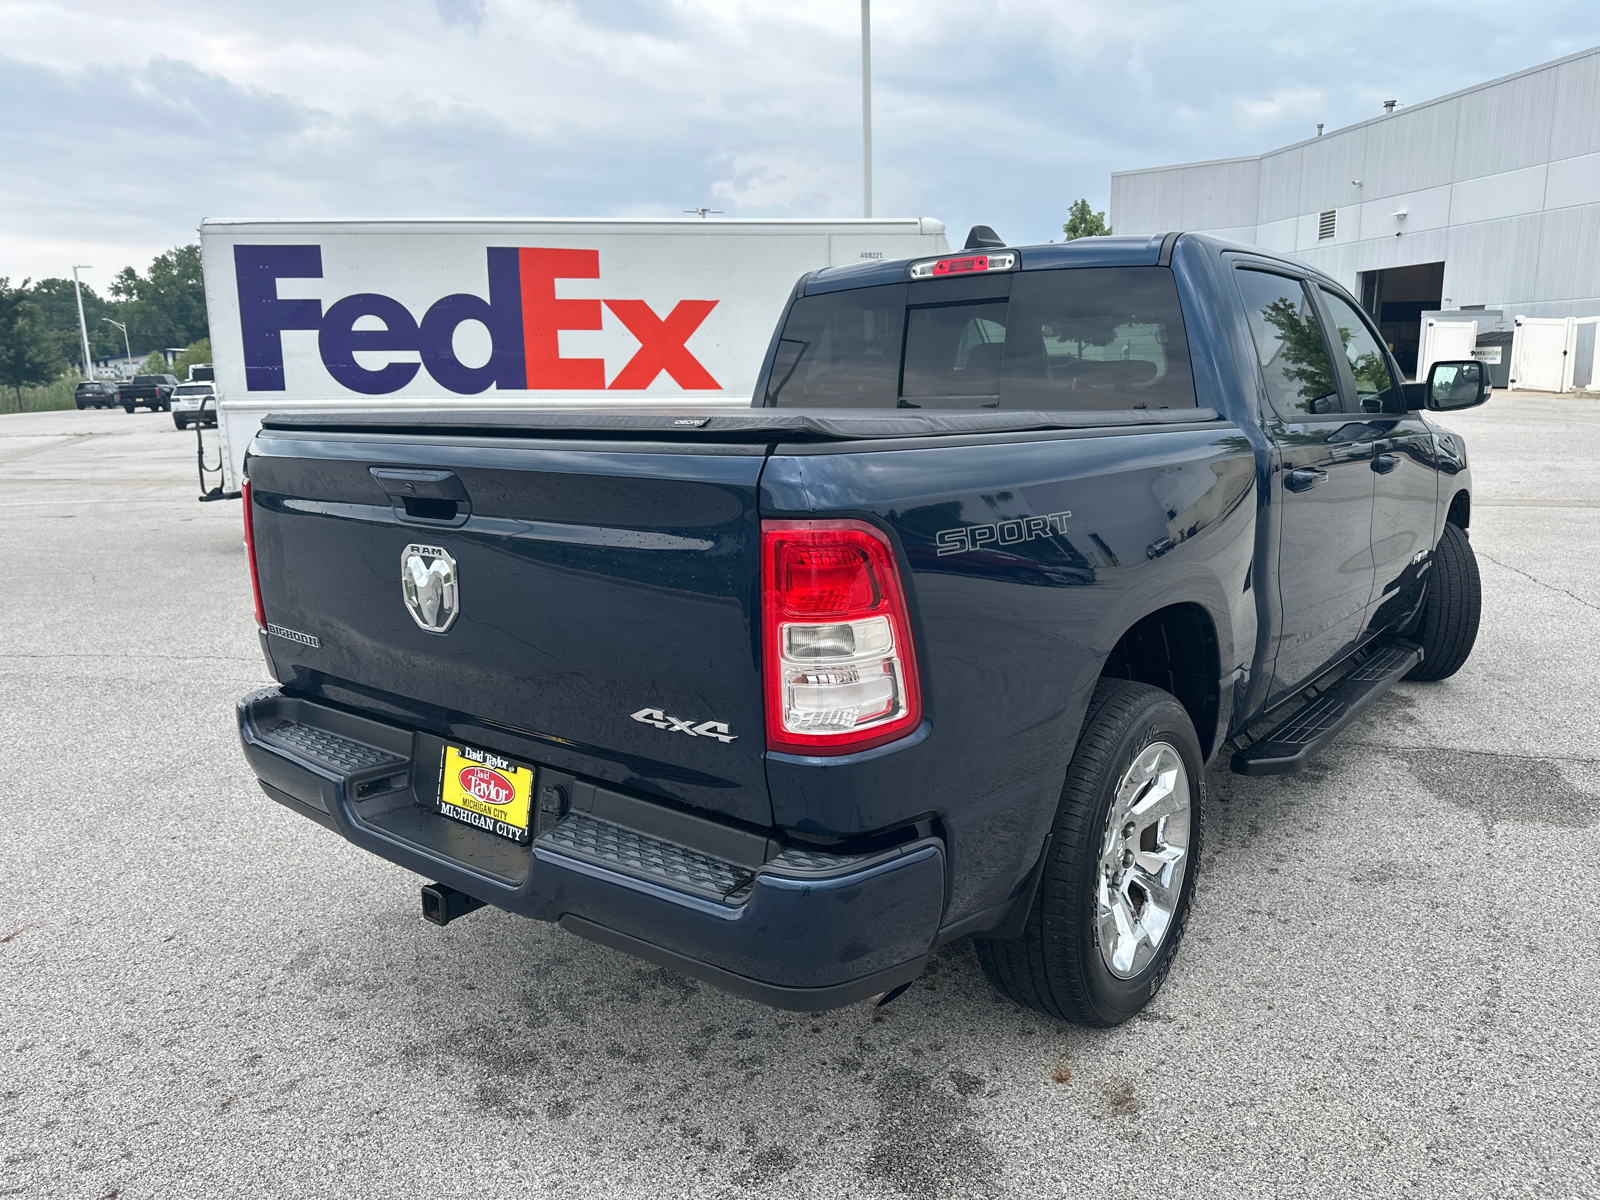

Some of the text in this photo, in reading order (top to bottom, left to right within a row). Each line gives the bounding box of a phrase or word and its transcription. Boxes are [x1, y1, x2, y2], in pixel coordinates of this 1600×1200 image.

[233, 244, 724, 395] FedEx
[935, 510, 1072, 557] SPORT
[410, 545, 442, 556] RAM
[268, 623, 319, 648] BIGHORN
[465, 746, 508, 770] David Taylor
[474, 767, 490, 780] David
[467, 775, 509, 803] Taylor
[440, 802, 522, 841] MICHIGAN CITY
[462, 797, 508, 821] MICHIGAN CITY
